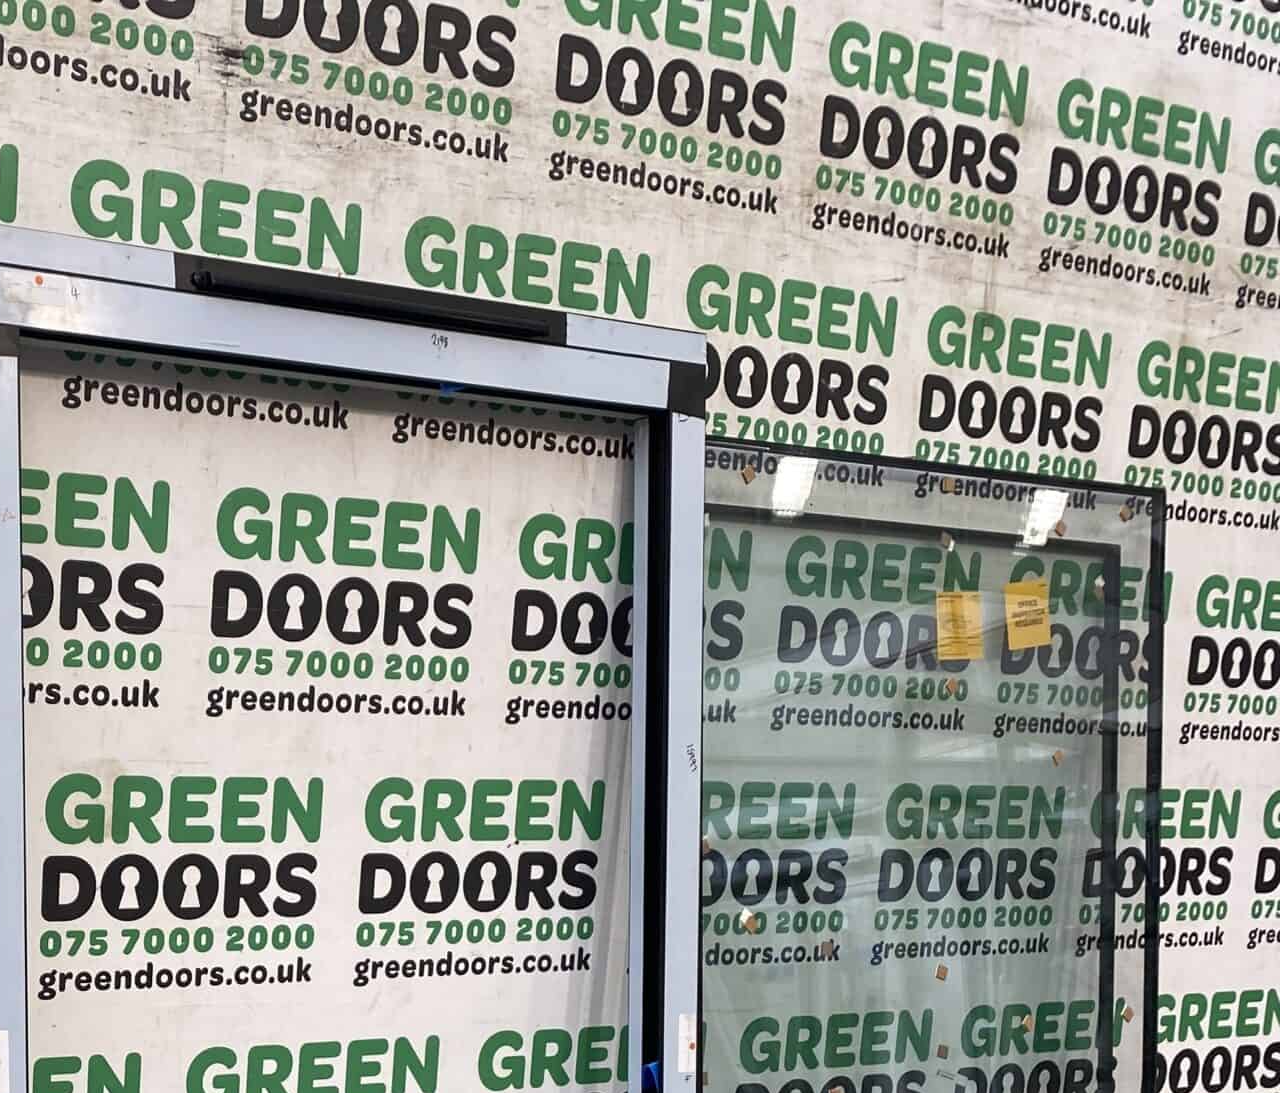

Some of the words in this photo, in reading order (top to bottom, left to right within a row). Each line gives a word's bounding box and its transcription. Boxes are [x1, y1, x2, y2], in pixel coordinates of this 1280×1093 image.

[91, 13, 193, 60] 2000
[242, 45, 309, 84] 075
[323, 61, 413, 106] 7000
[425, 83, 512, 125] 2000
[555, 33, 787, 146] DOORS
[829, 21, 1029, 127] GREEN
[239, 90, 508, 162] greendoors.co.uk
[553, 109, 609, 145] 075
[621, 124, 697, 163] 7000
[707, 142, 781, 180] 2000
[819, 94, 1020, 195] DOORS
[1057, 78, 1232, 174] GREEN
[549, 150, 778, 214] greendoors.co.uk
[816, 165, 865, 197] 075
[875, 177, 941, 212] 7000
[949, 192, 1013, 226] 2000
[1047, 146, 1222, 237] DOORS
[73, 162, 360, 276] GREEN
[812, 202, 1009, 258] greendoors.co.uk
[1044, 211, 1086, 241] 075
[1094, 222, 1152, 254] 7000
[1158, 236, 1215, 266] 2000
[405, 218, 650, 318] GREEN
[1039, 246, 1211, 296] greendoors.co.uk
[1240, 252, 1278, 279] 075
[686, 265, 897, 357] GREEN
[927, 306, 1111, 389] GREEN
[64, 374, 347, 427] greendoors.co.uk
[919, 374, 1103, 452] DOORS
[393, 412, 634, 458] greendoors.co.uk
[738, 415, 808, 446] 7000
[817, 425, 884, 455] 2000
[916, 438, 961, 464] 075
[970, 445, 1030, 472] 7000
[1038, 453, 1097, 480] 2000
[1124, 464, 1164, 488] 075
[1171, 471, 1224, 497] 7000
[216, 488, 480, 574] GREEN
[210, 570, 473, 649] DOORS
[64, 640, 162, 671] 2000
[208, 646, 272, 675] 075
[286, 650, 373, 679] 7000
[385, 654, 468, 682] 2000
[507, 660, 565, 686] 075
[205, 685, 465, 717] greendoors.co.uk
[775, 670, 823, 695] 075
[832, 674, 897, 698] 7000
[996, 682, 1038, 705] 075
[1184, 692, 1221, 713] 075
[1227, 694, 1277, 715] 7000
[771, 704, 965, 731] greendoors.co.uk
[45, 774, 323, 844] GREEN
[364, 777, 605, 842] GREEN
[885, 783, 1066, 840] GREEN
[41, 853, 317, 922] DOORS
[358, 850, 598, 914] DOORS
[877, 847, 1058, 902] DOORS
[356, 922, 414, 947] 075
[426, 919, 506, 945] 7000
[517, 916, 593, 941] 2000
[776, 910, 843, 933] 2000
[874, 909, 919, 931] 075
[927, 907, 986, 929] 7000
[994, 905, 1052, 927] 2000
[1177, 901, 1226, 921] 2000
[40, 930, 107, 957] 075
[122, 927, 213, 955] 7000
[226, 924, 314, 951] 2000
[352, 947, 590, 987] greendoors.co.uk
[871, 932, 1049, 965] greendoors.co.uk
[38, 957, 311, 1000] greendoors.co.uk
[740, 1009, 934, 1074] GREEN
